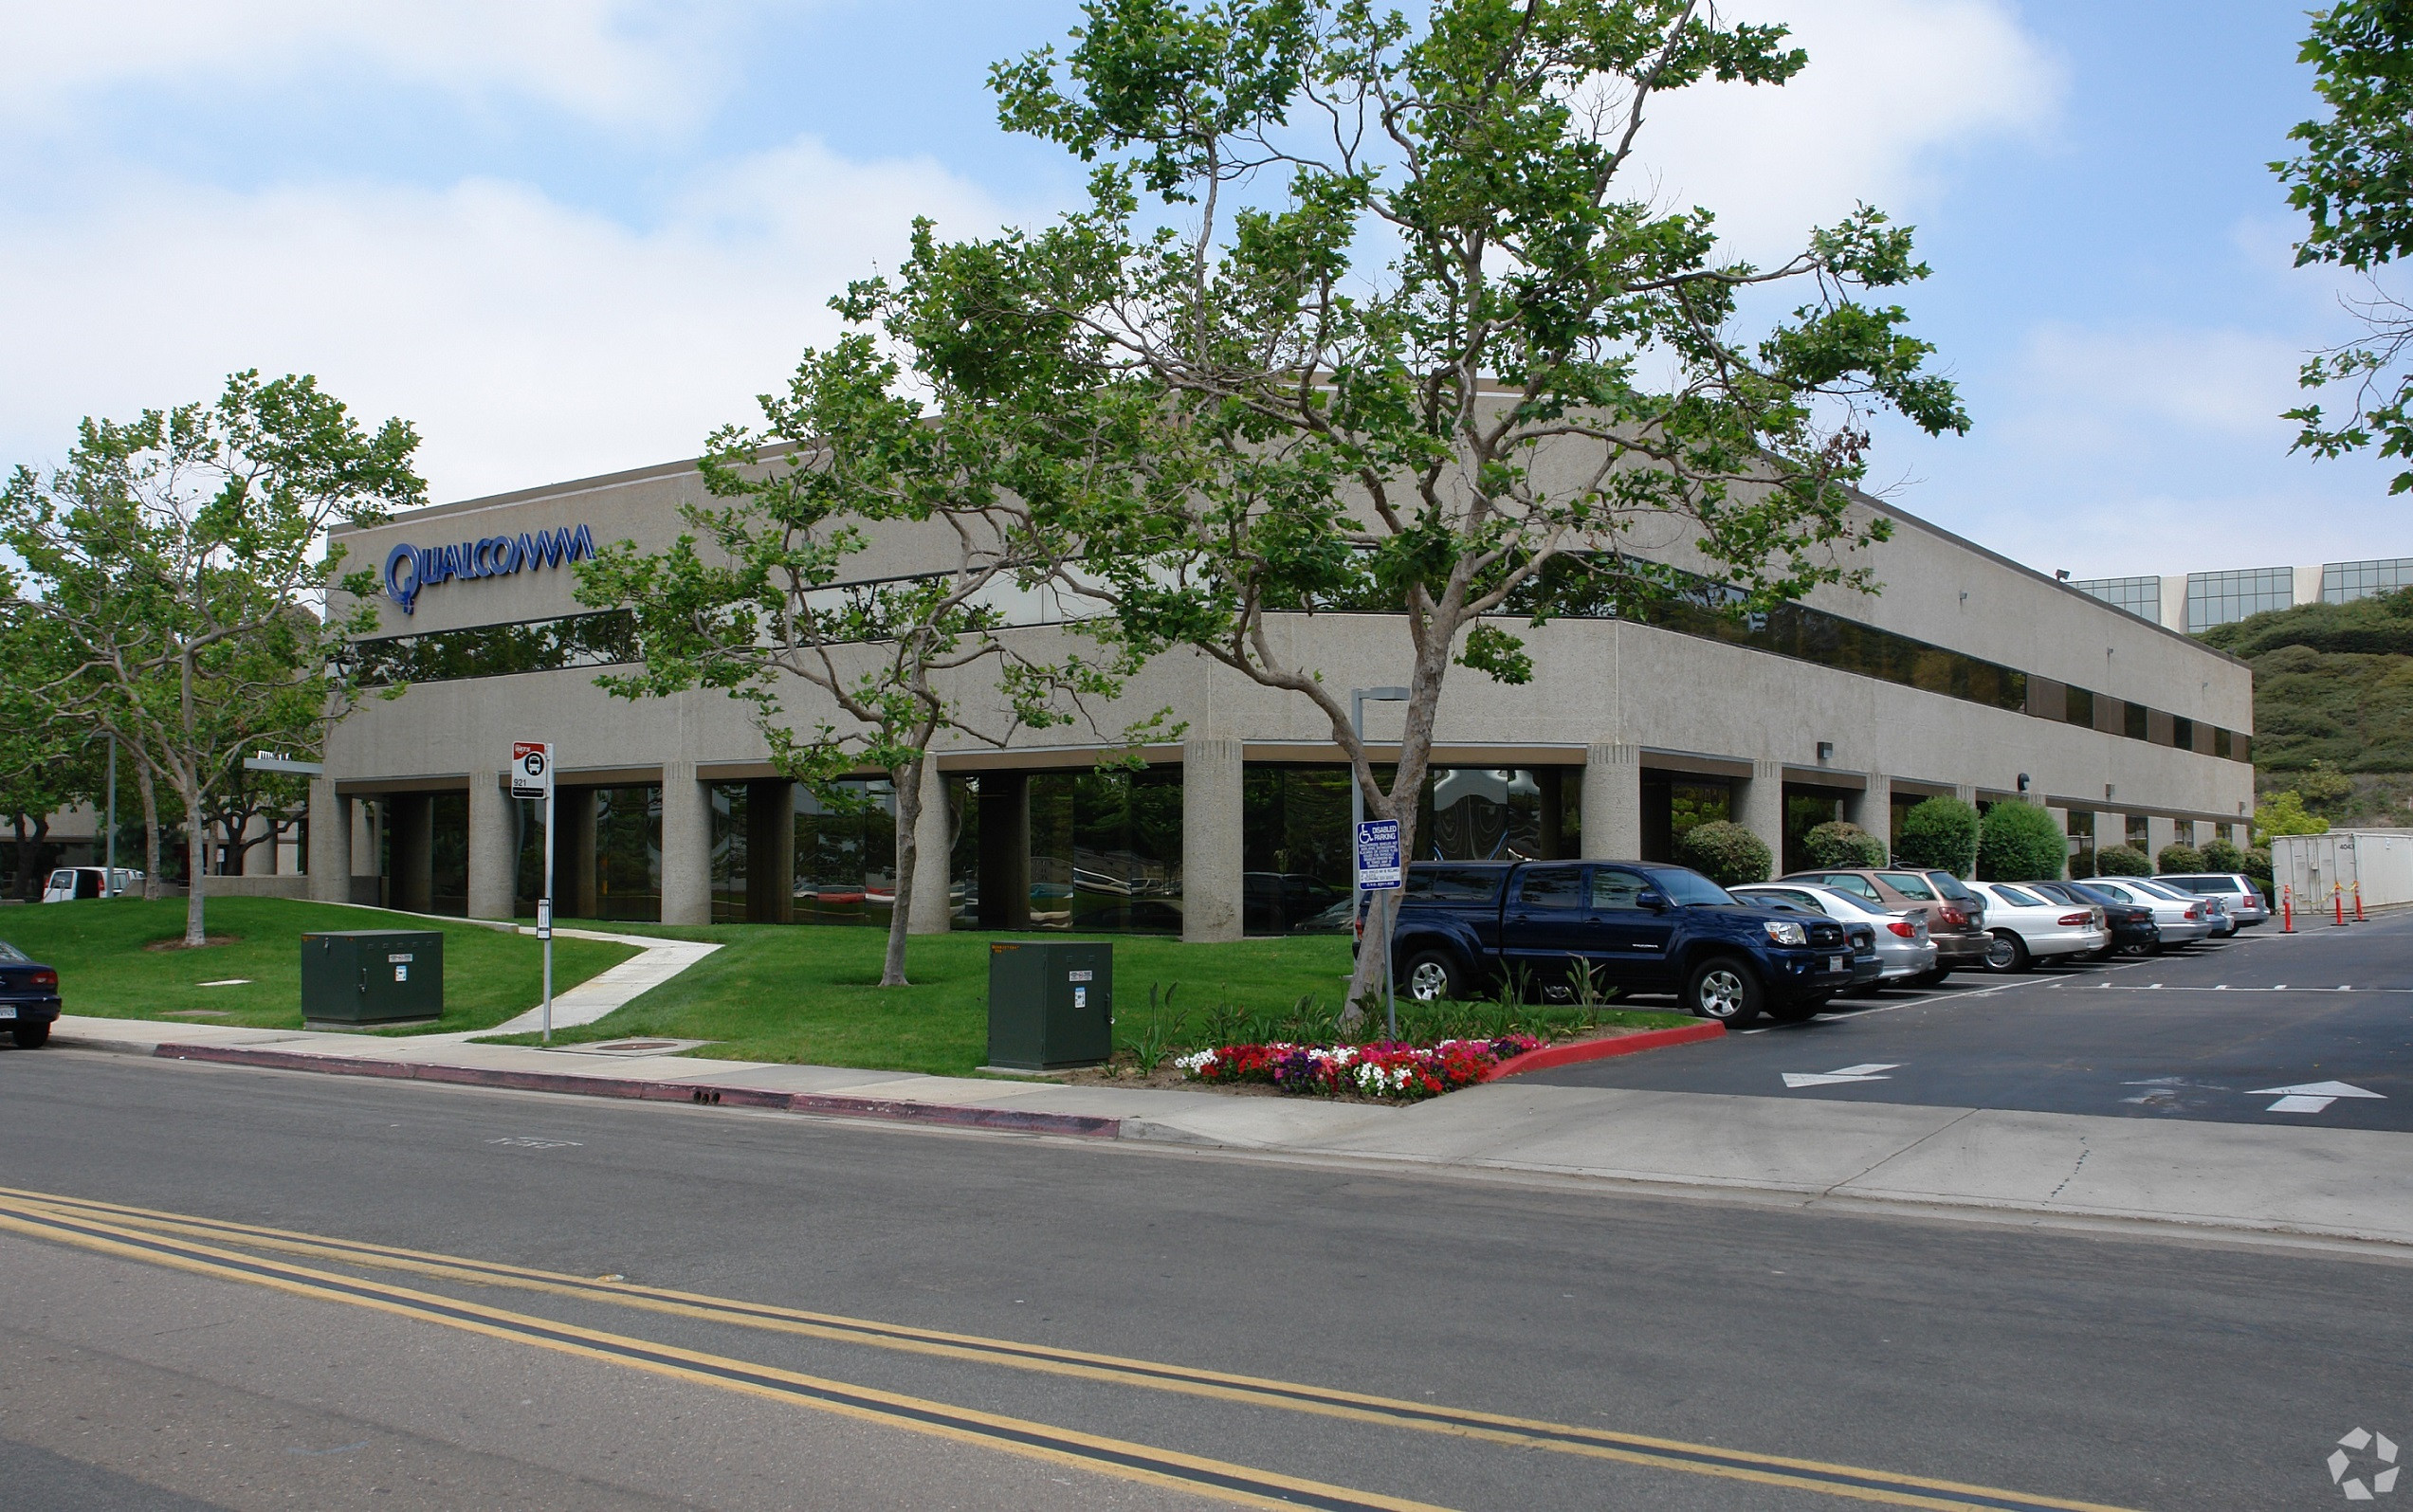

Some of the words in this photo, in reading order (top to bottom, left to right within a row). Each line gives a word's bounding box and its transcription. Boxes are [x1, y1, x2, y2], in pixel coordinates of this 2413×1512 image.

[384, 523, 596, 615] QUALCOMM
[513, 778, 527, 787] 921
[1372, 826, 1398, 834] DISABLED
